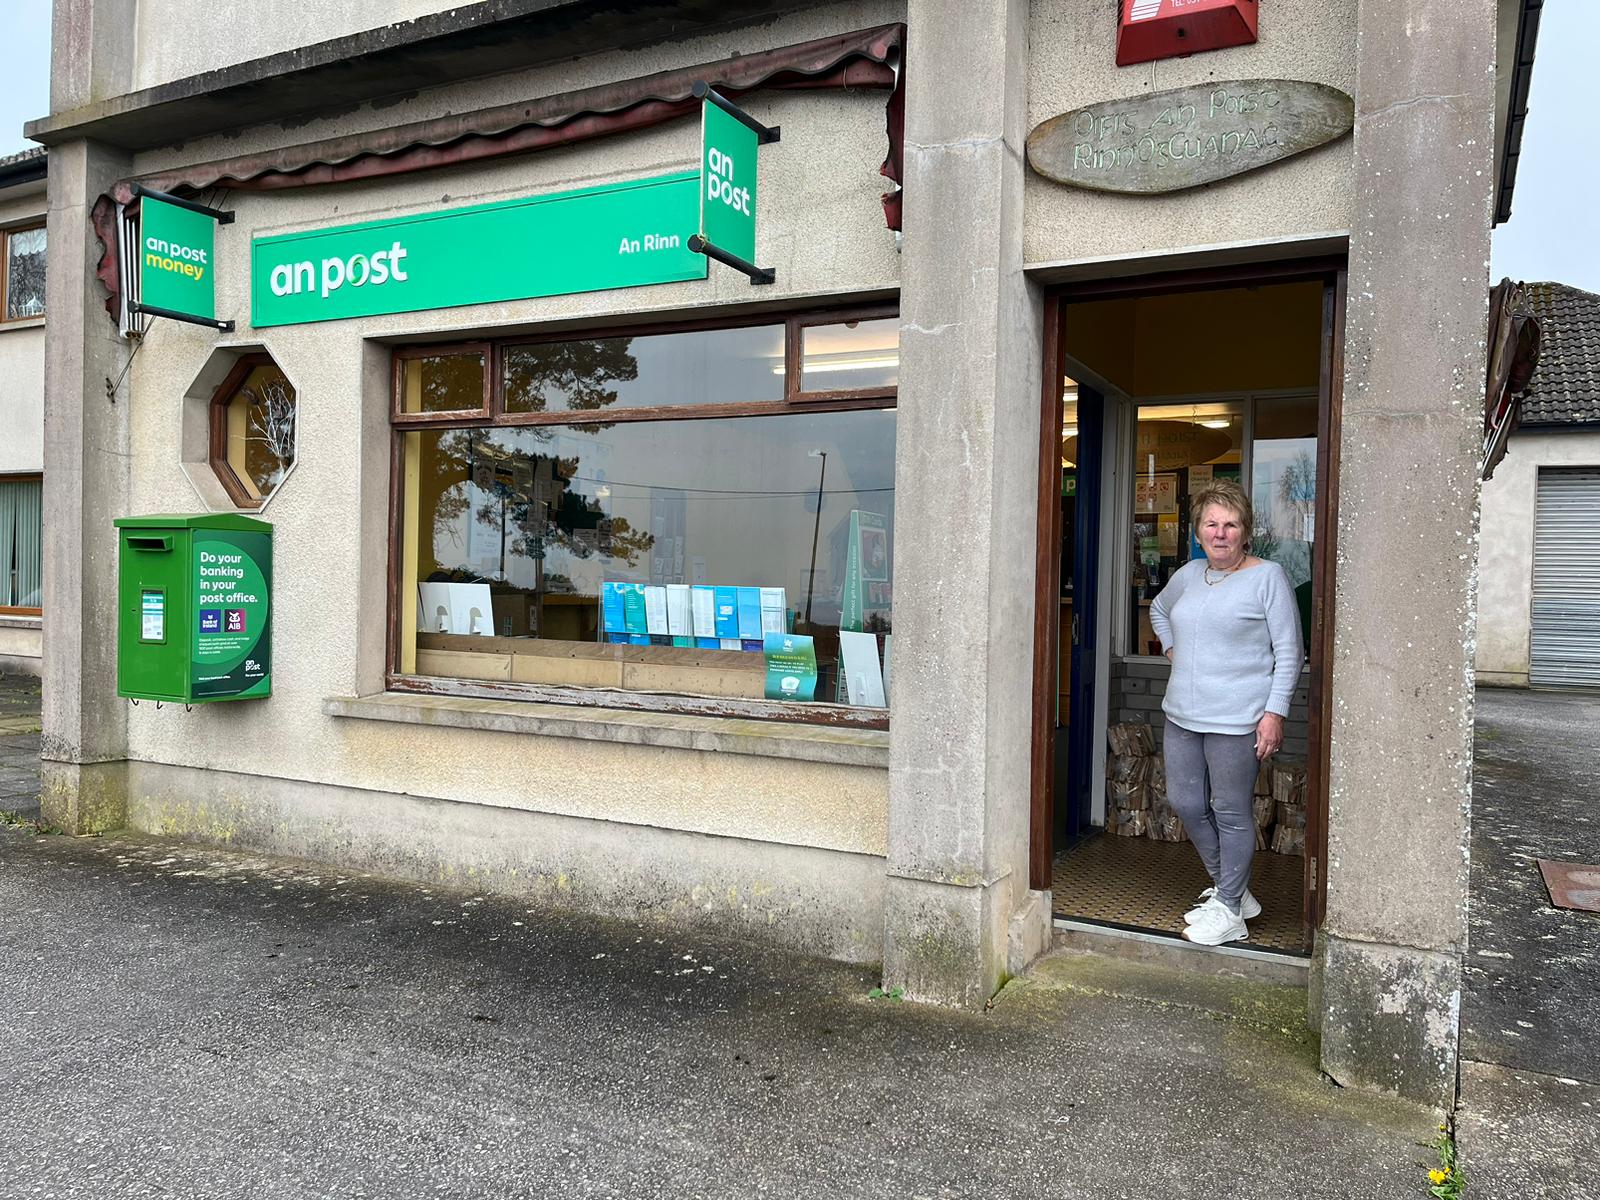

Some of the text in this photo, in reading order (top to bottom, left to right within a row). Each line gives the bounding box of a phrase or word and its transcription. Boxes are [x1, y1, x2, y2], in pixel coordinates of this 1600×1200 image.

[708, 147, 733, 181] an
[707, 171, 750, 217] post
[146, 237, 207, 265] an post
[618, 233, 680, 254] An Rinn
[146, 252, 204, 281] money
[270, 241, 408, 299] an post
[200, 551, 242, 565] Do your
[200, 565, 244, 579] banking
[200, 579, 236, 592] in your
[199, 592, 258, 605] post office.
[228, 622, 241, 630] AIB
[245, 663, 261, 672] post
